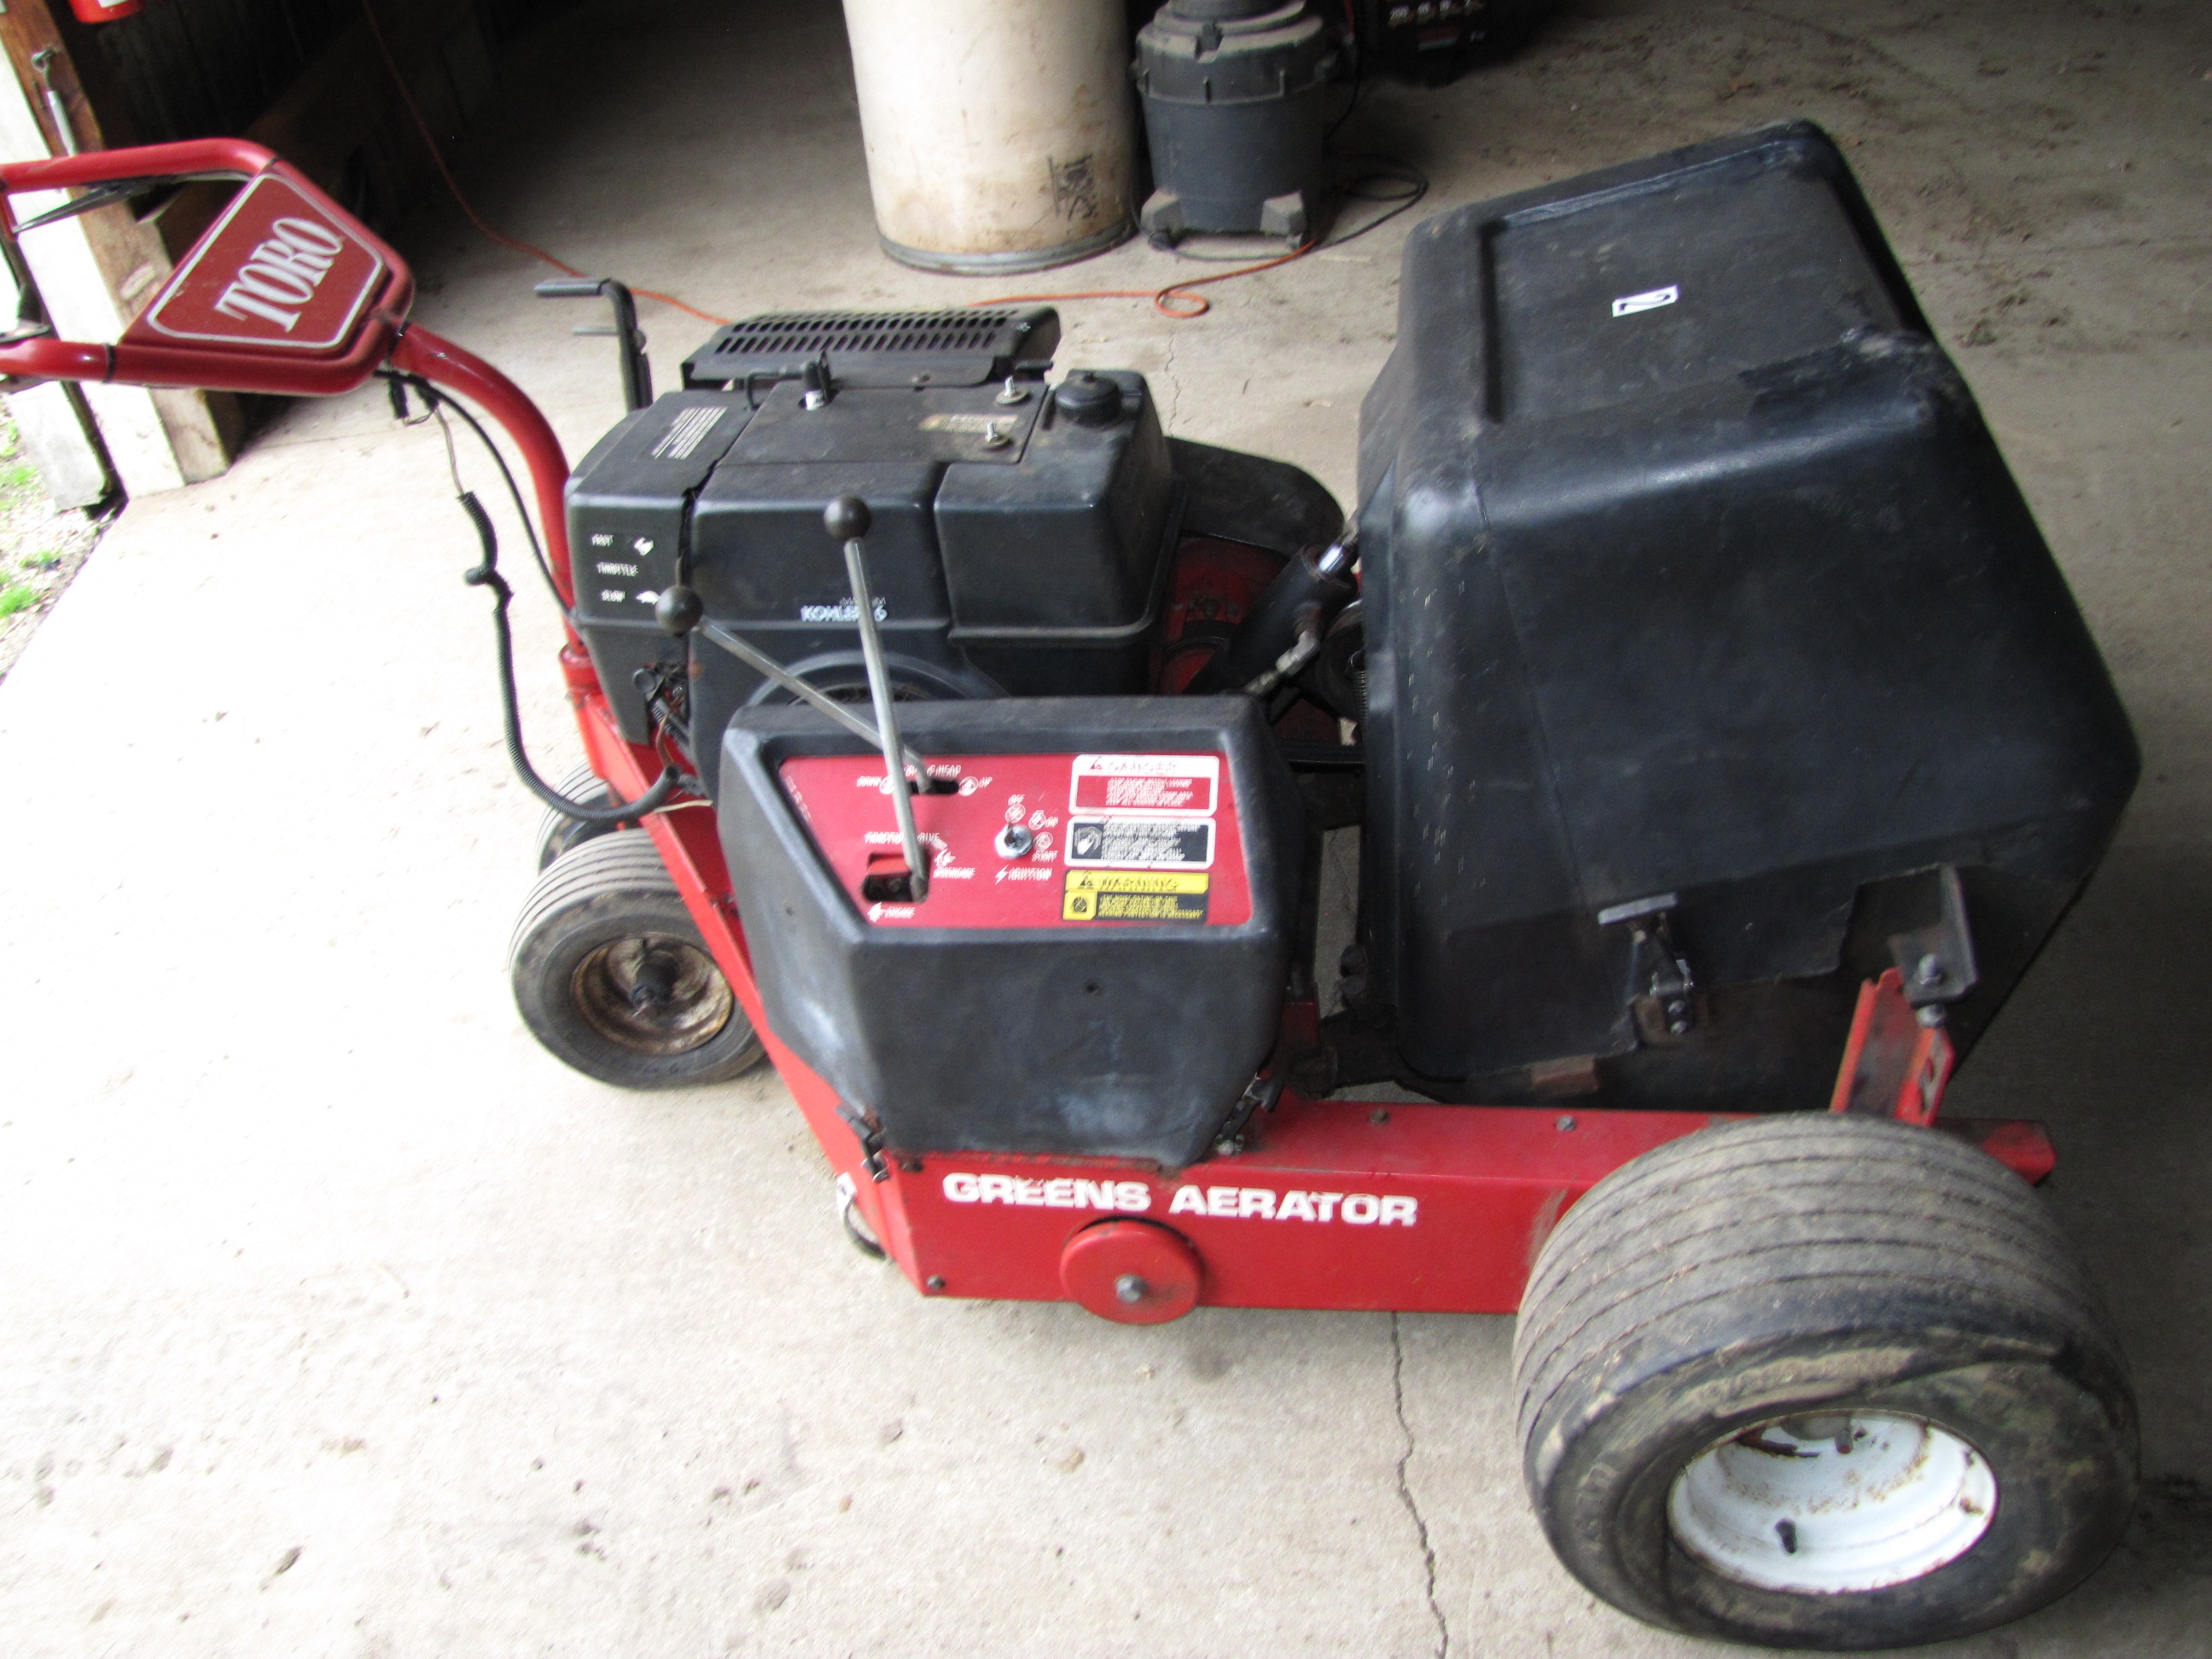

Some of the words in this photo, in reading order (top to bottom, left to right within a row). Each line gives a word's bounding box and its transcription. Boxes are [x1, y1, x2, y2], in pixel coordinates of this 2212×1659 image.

[214, 218, 344, 333] TORO
[591, 534, 614, 547] FAST
[597, 562, 638, 577] THROTTLE
[601, 589, 626, 602] SLOW
[1108, 760, 1177, 775] DANGER
[979, 777, 992, 788] UP
[864, 831, 906, 844] TRACTIO
[1008, 867, 1052, 881] IGNITION
[1100, 874, 1179, 892] WARNING
[884, 906, 916, 918] ENGAGE
[942, 1172, 1151, 1212] GREENS
[1168, 1184, 1417, 1226] AERATOR
